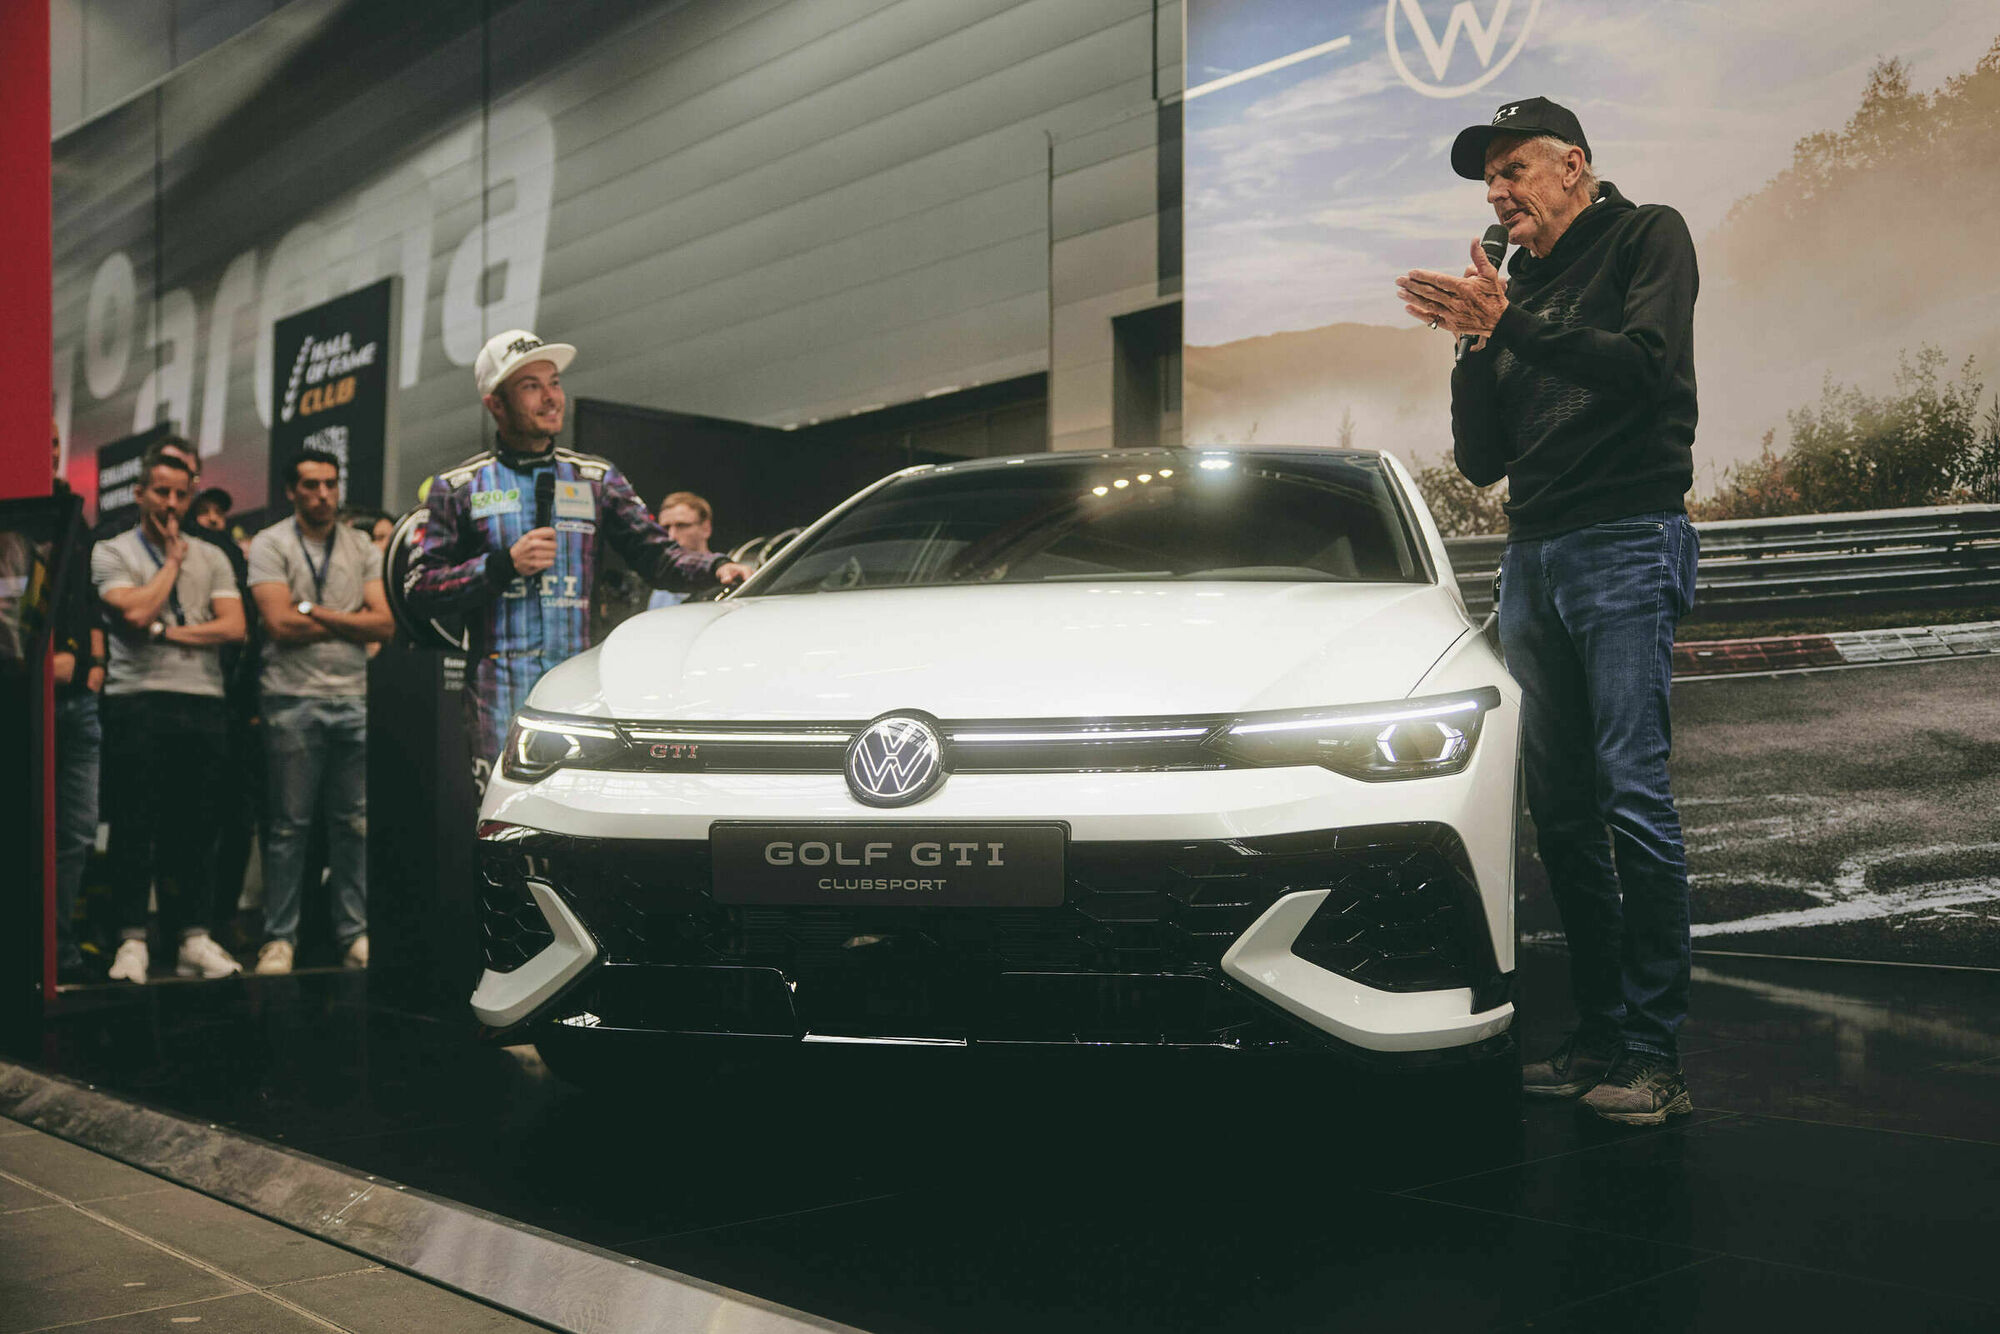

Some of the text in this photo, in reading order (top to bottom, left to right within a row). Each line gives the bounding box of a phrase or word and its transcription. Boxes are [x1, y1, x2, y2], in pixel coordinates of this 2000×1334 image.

[300, 376, 357, 417] CLUB
[649, 744, 699, 759] GTI
[764, 841, 1004, 867] GOLF GTI
[818, 878, 947, 891] CLUBSPORT
